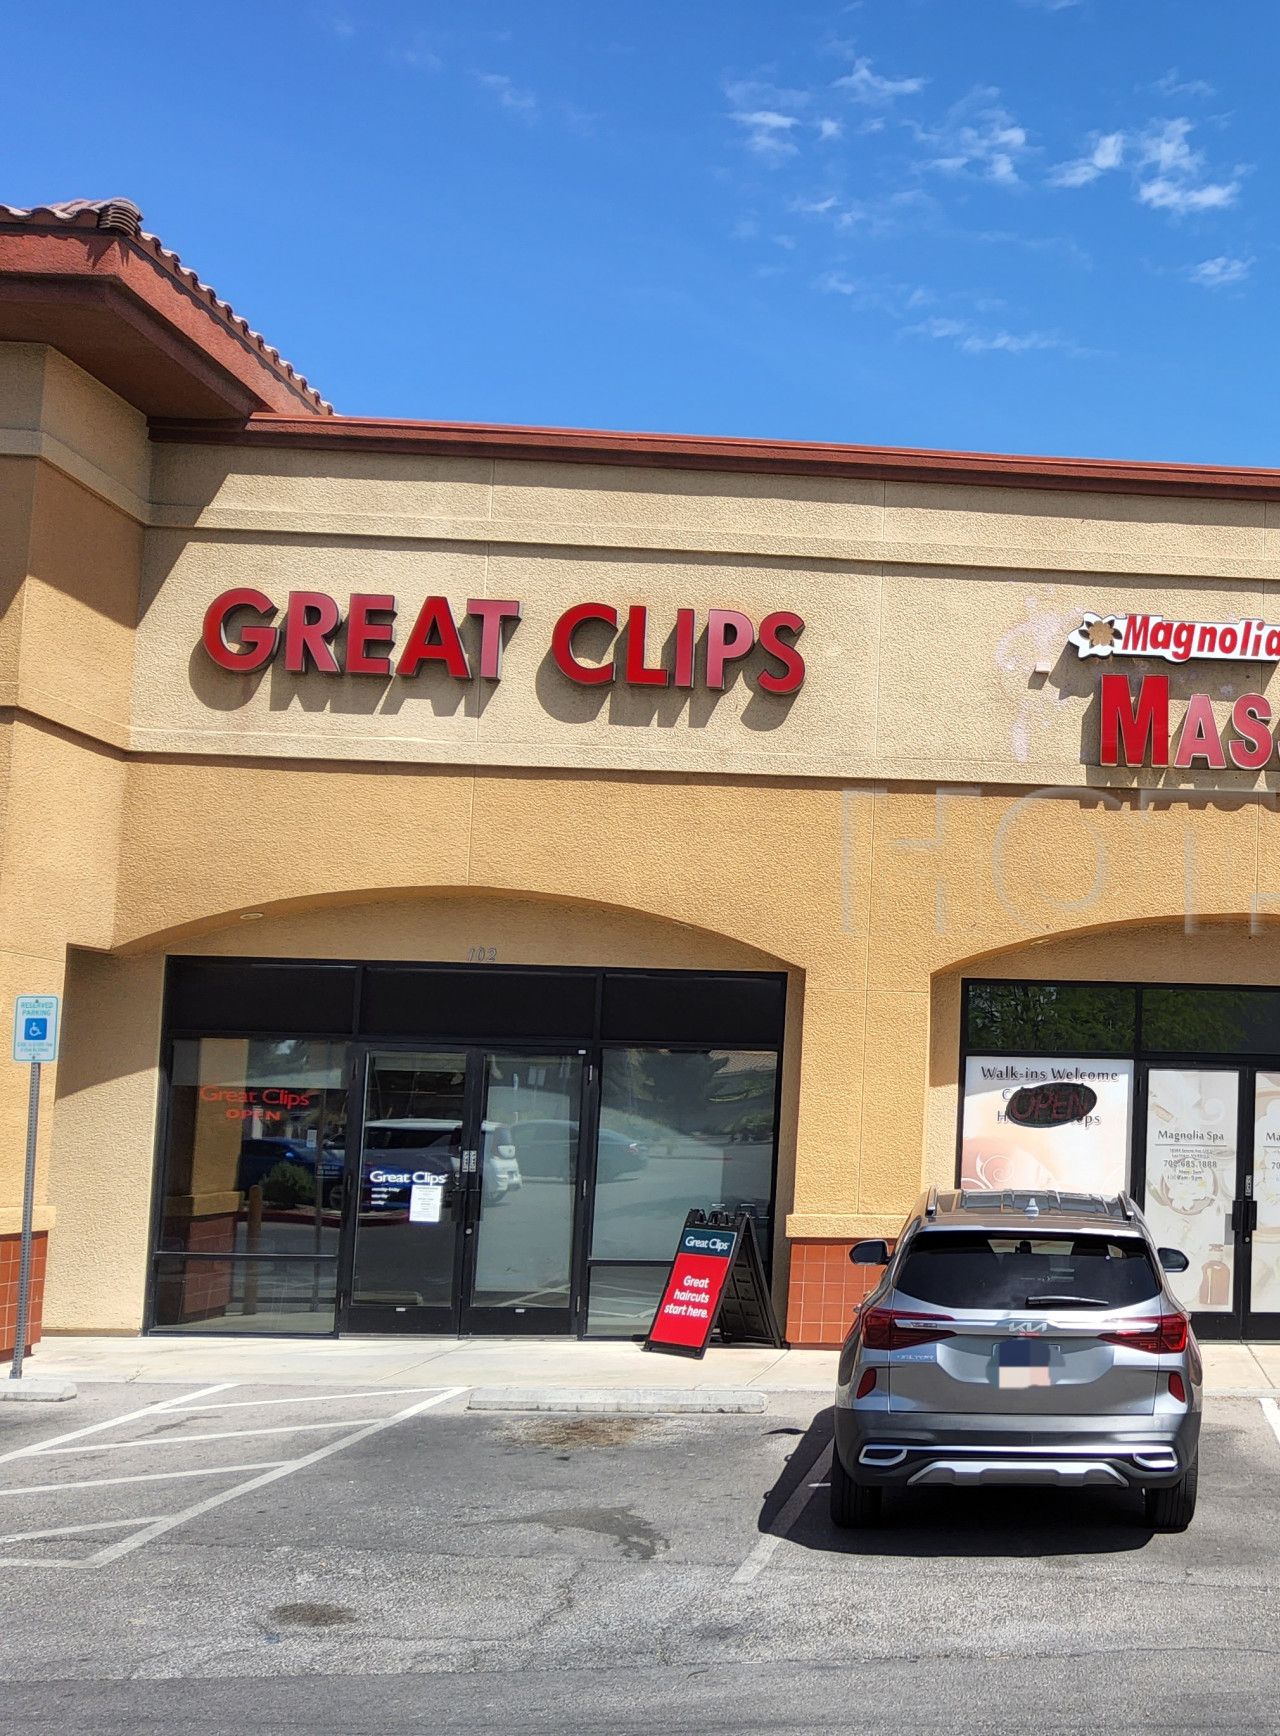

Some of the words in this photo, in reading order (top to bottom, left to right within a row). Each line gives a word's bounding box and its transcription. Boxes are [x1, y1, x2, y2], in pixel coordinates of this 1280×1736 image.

[202, 587, 521, 682] GREAT
[552, 603, 807, 694] CLIPS
[466, 946, 497, 961] 102
[981, 1066, 1047, 1080] Walk-ins
[1051, 1067, 1119, 1081] Welcome
[200, 1084, 256, 1103] Great
[262, 1089, 311, 1109] Clips
[1010, 1091, 1089, 1120] OPEN
[225, 1109, 281, 1120] OPEN
[1158, 1130, 1204, 1142] Magnolia
[1207, 1131, 1224, 1142] Spa
[369, 1171, 410, 1183] Great
[412, 1171, 447, 1186] Clips
[685, 1236, 708, 1248] Great
[709, 1238, 730, 1251] Clips
[683, 1275, 709, 1288] Great
[673, 1289, 709, 1303] haircuts
[664, 1303, 686, 1315] start
[687, 1306, 708, 1318] here.
